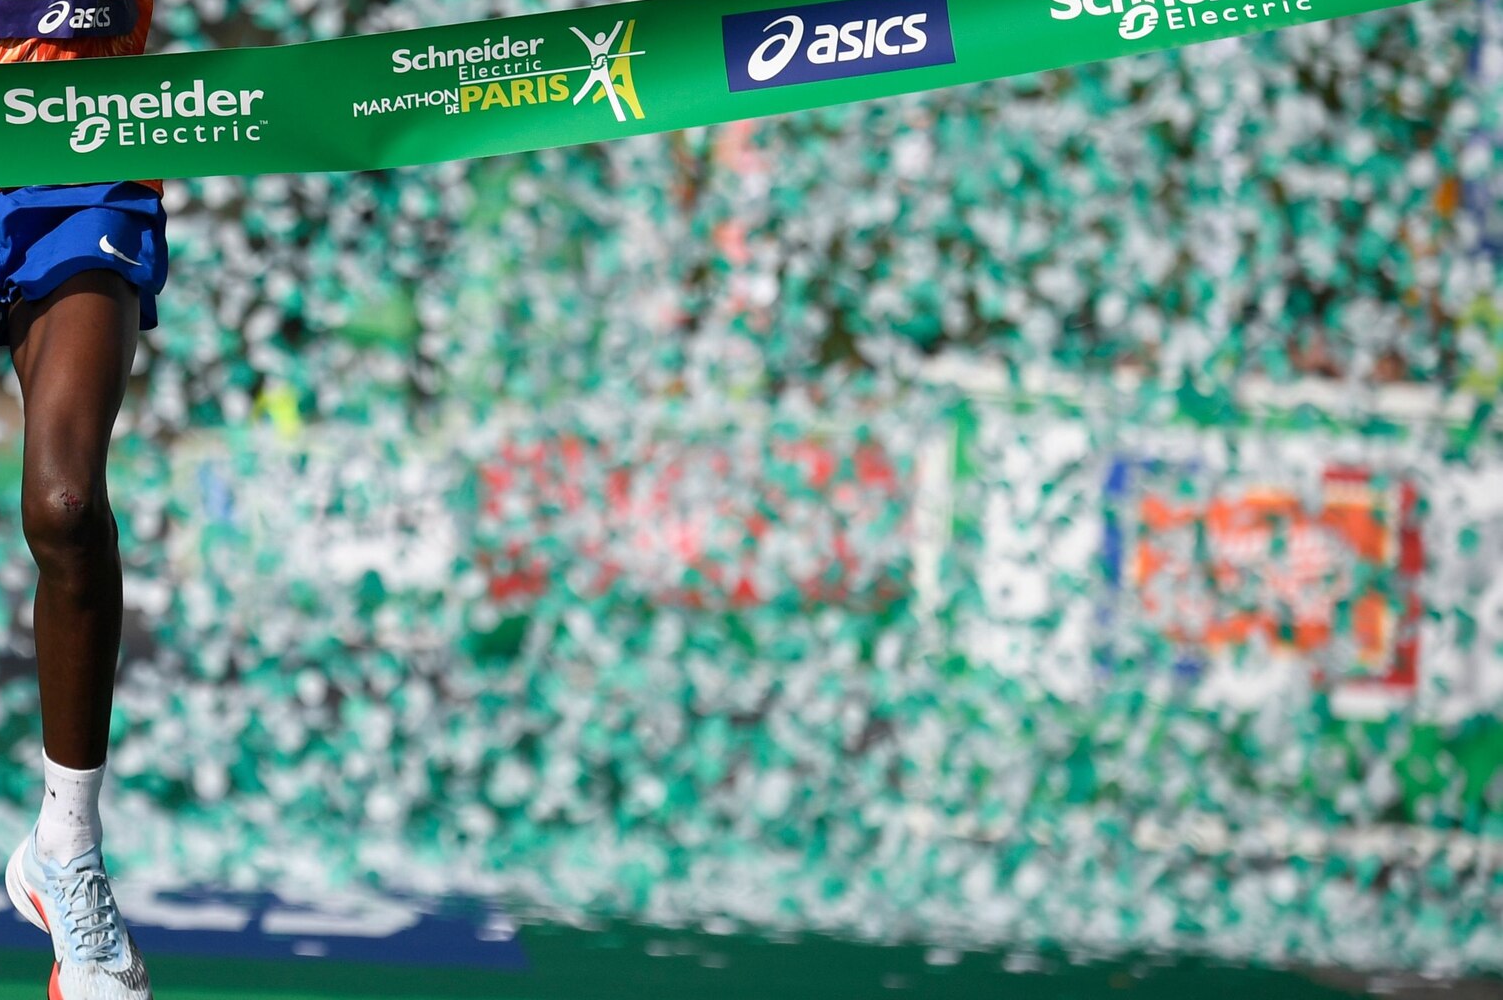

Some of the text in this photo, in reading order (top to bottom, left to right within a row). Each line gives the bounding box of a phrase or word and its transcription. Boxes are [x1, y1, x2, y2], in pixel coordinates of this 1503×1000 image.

[391, 35, 544, 74] Schneider
[458, 61, 542, 82] Electric
[3, 80, 264, 125] Schneider
[353, 75, 570, 118] MARATHON DE PARIS
[118, 123, 261, 147] Electric
